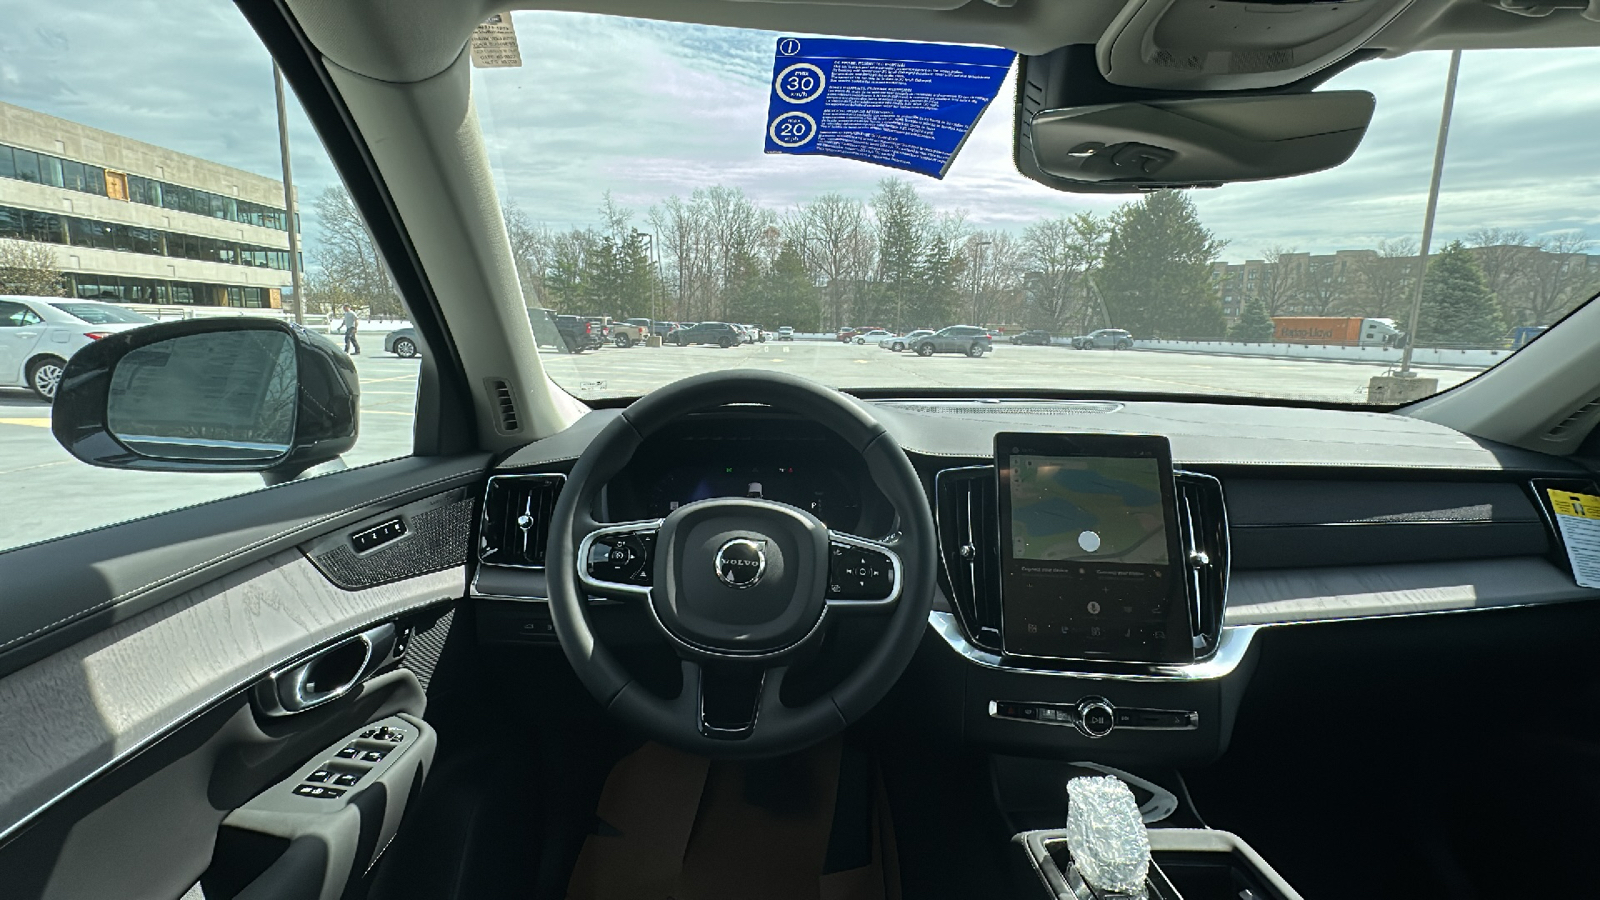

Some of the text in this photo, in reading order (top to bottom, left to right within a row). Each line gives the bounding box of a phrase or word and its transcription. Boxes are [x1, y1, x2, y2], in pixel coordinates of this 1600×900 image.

[787, 76, 815, 91] 30
[781, 123, 806, 136] 20
[721, 558, 759, 567] VOLVO
